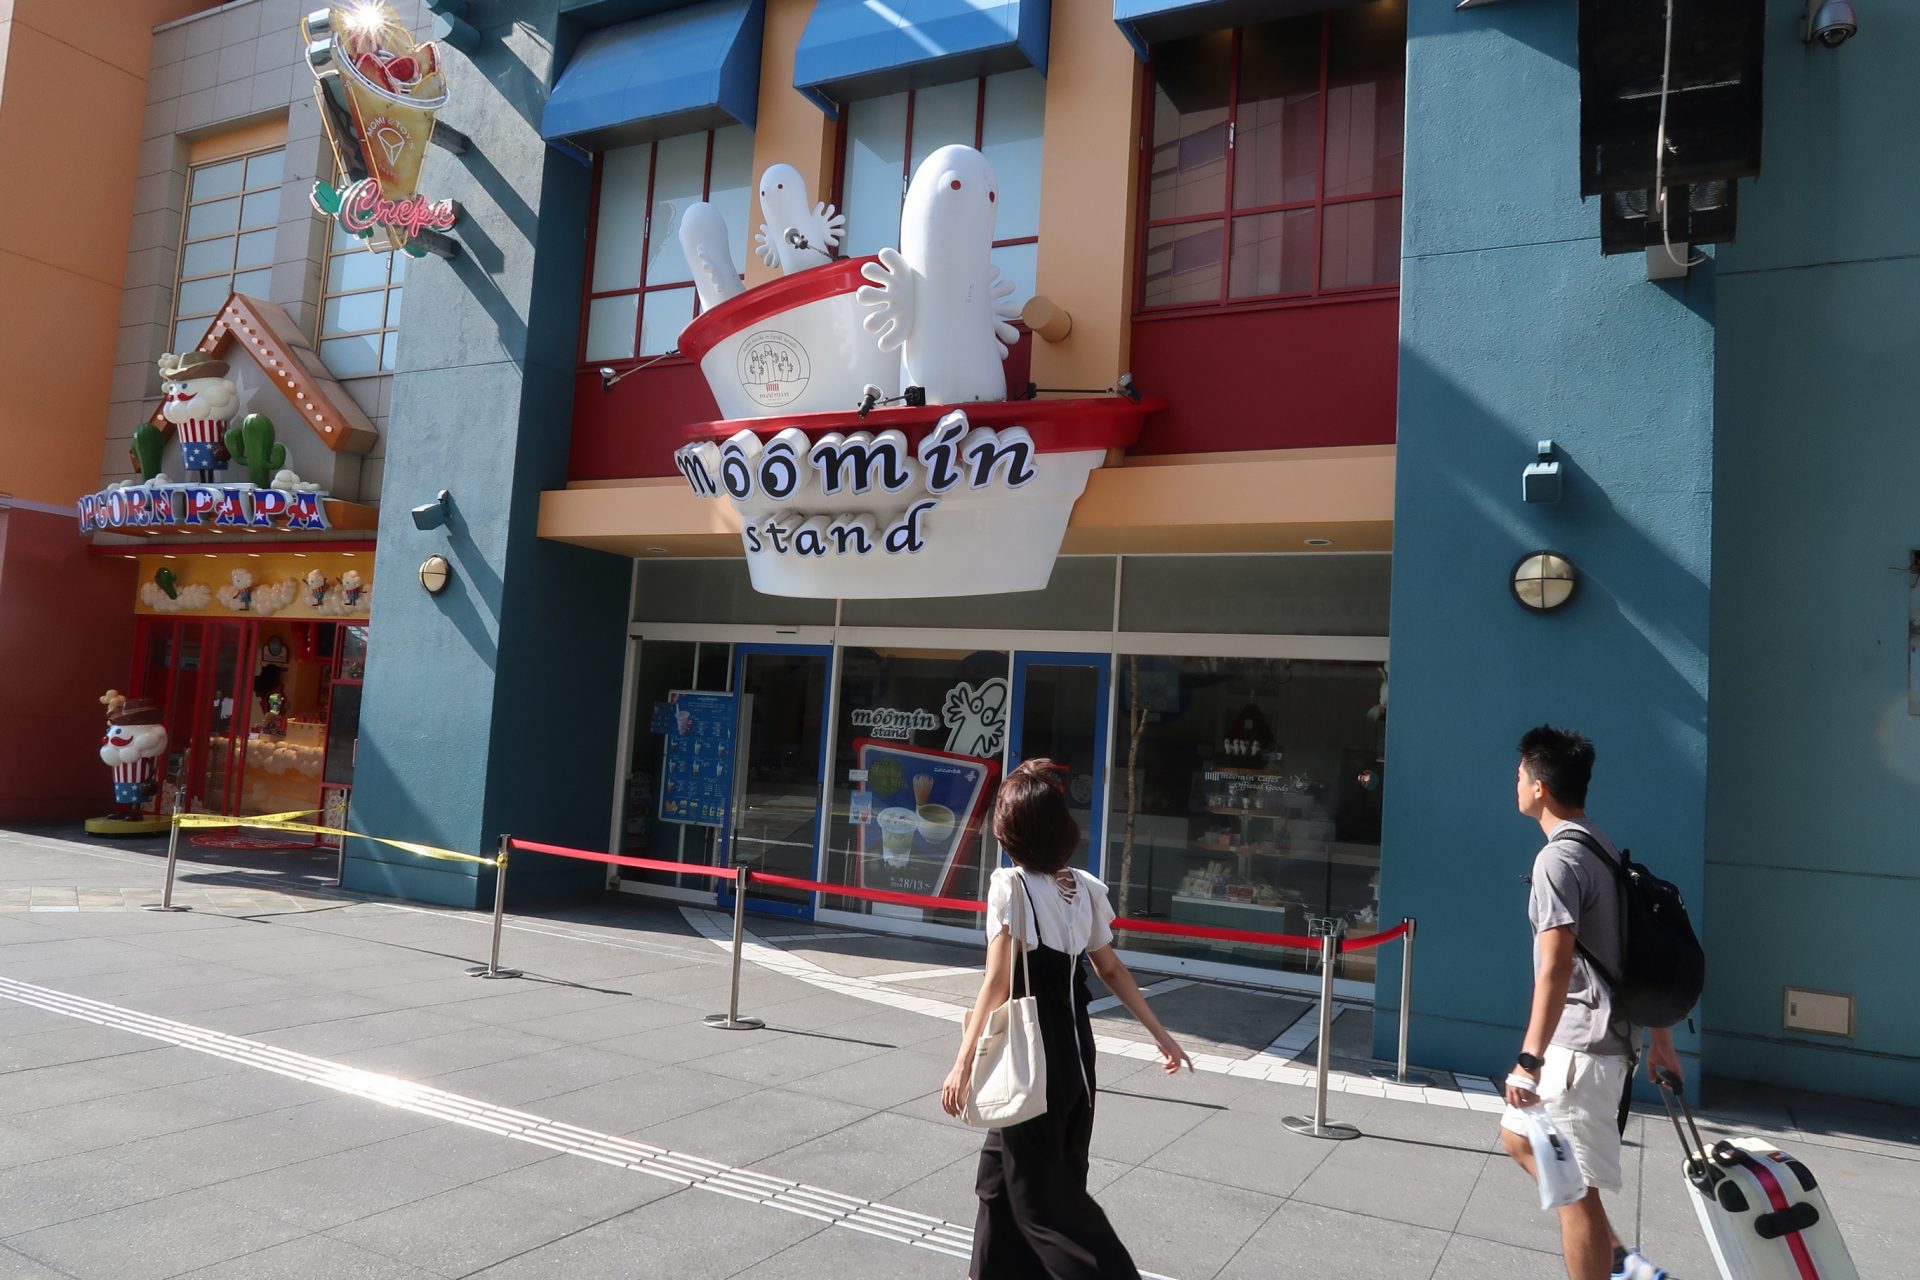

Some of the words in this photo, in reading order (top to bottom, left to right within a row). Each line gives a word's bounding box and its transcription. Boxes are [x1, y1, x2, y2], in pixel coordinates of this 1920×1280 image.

[367, 116, 386, 137] MOMI
[345, 177, 455, 238] Crepe
[78, 487, 175, 533] OPCORN
[184, 487, 329, 531] PAPA
[746, 501, 938, 556] stand
[872, 726, 909, 739] stand
[1265, 784, 1289, 793] Goods
